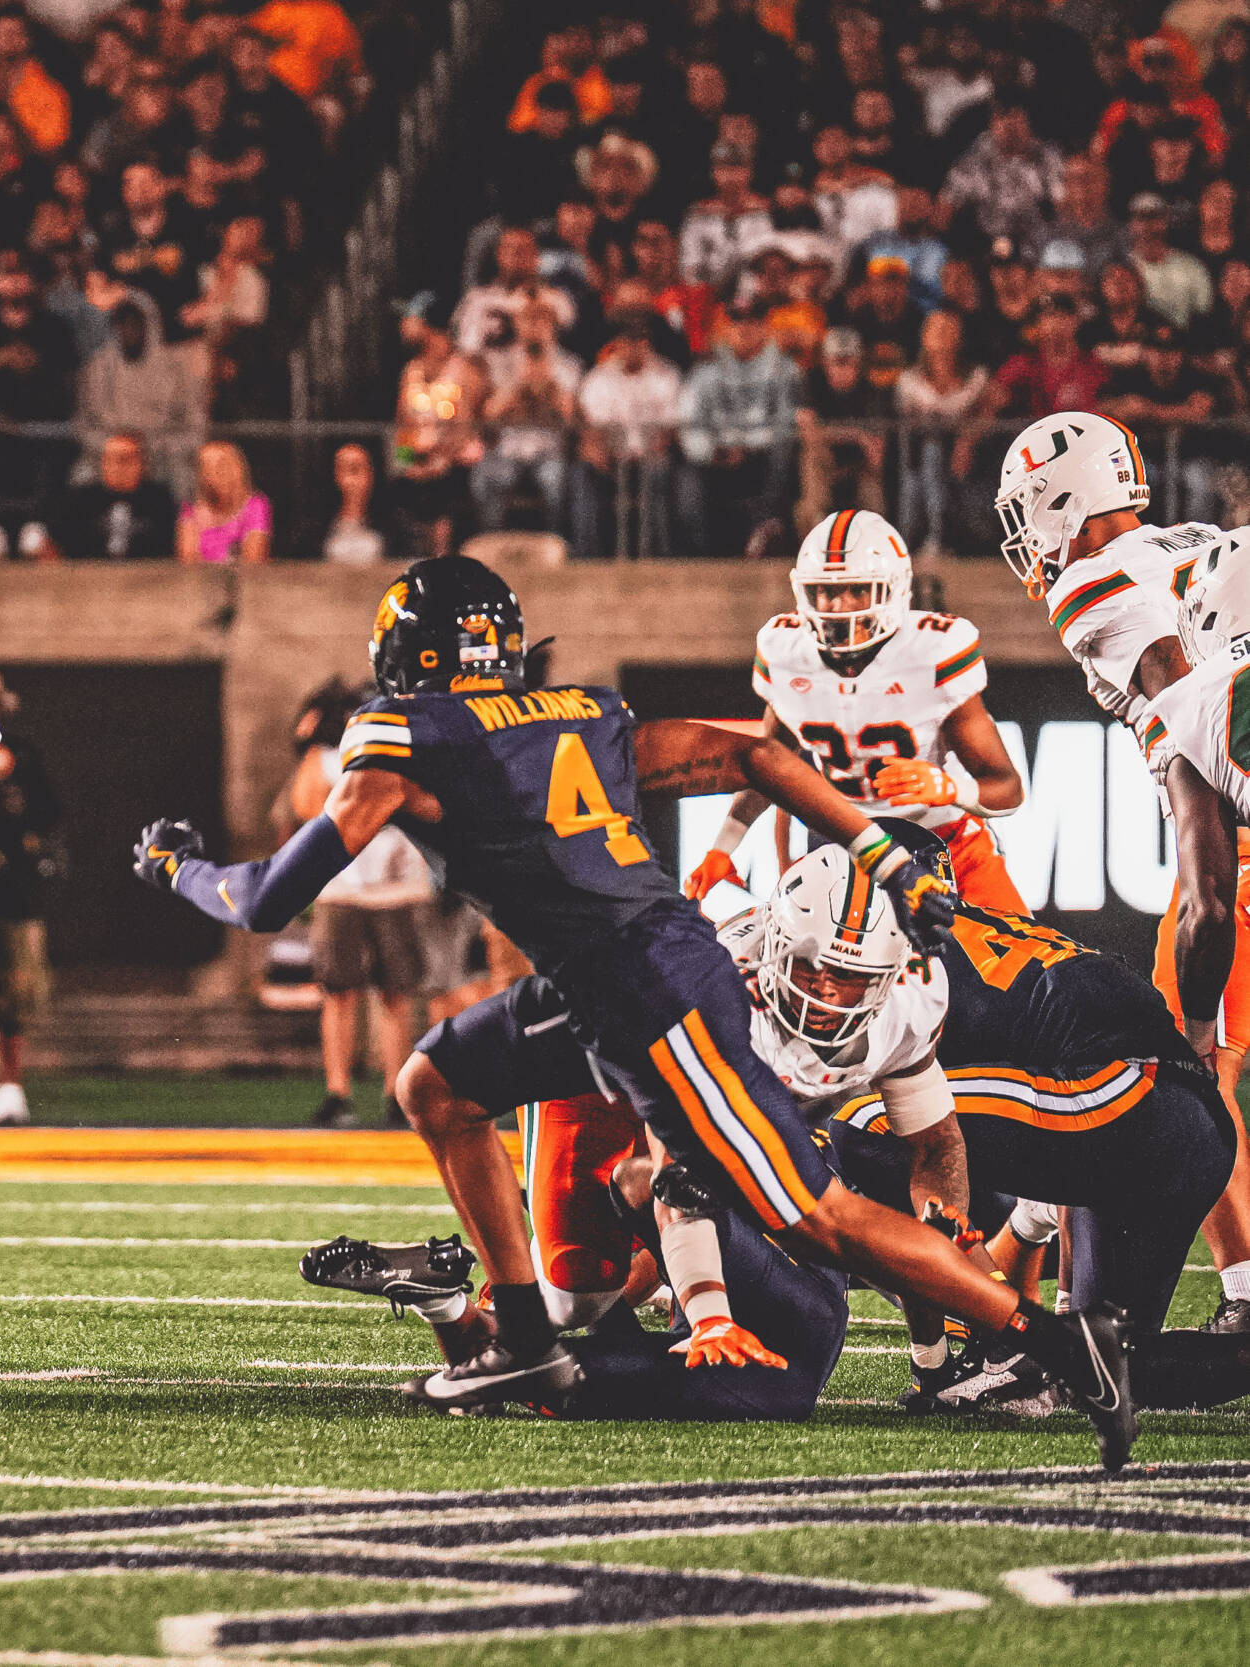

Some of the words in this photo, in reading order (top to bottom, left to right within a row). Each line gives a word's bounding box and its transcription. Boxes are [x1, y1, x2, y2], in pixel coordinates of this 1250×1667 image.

[1020, 430, 1069, 473] U
[463, 688, 603, 733] WILLIAMS
[545, 733, 650, 867] 4
[829, 942, 862, 958] MIAMI
